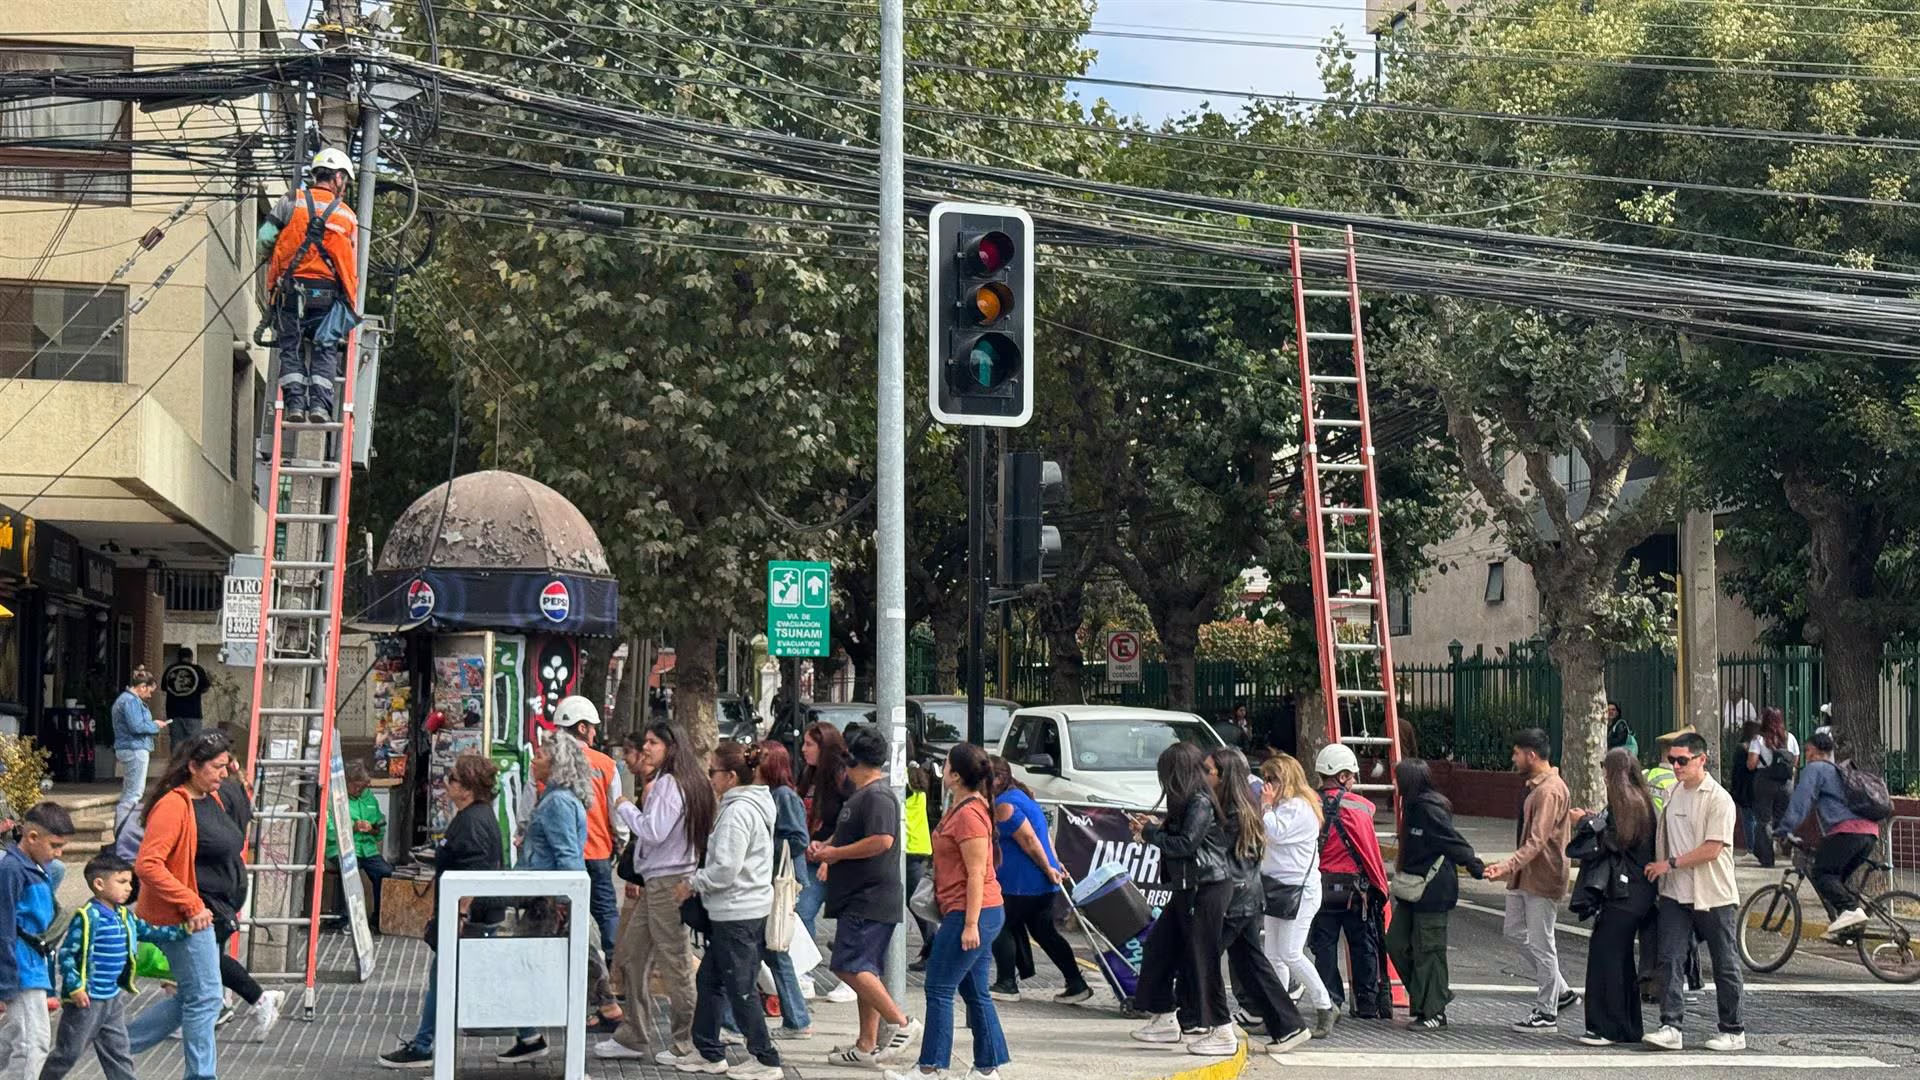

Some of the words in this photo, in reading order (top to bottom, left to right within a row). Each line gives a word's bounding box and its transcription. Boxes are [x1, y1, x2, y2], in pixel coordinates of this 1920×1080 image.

[230, 580, 263, 594] TARO
[786, 613, 799, 621] VIA
[801, 613, 811, 621] DE
[776, 620, 821, 628] EVACUACION
[774, 627, 823, 639] TSUNAMI
[776, 640, 821, 648] EVACUATION
[786, 648, 810, 656] ROUTE
[1087, 840, 1161, 884] INGR
